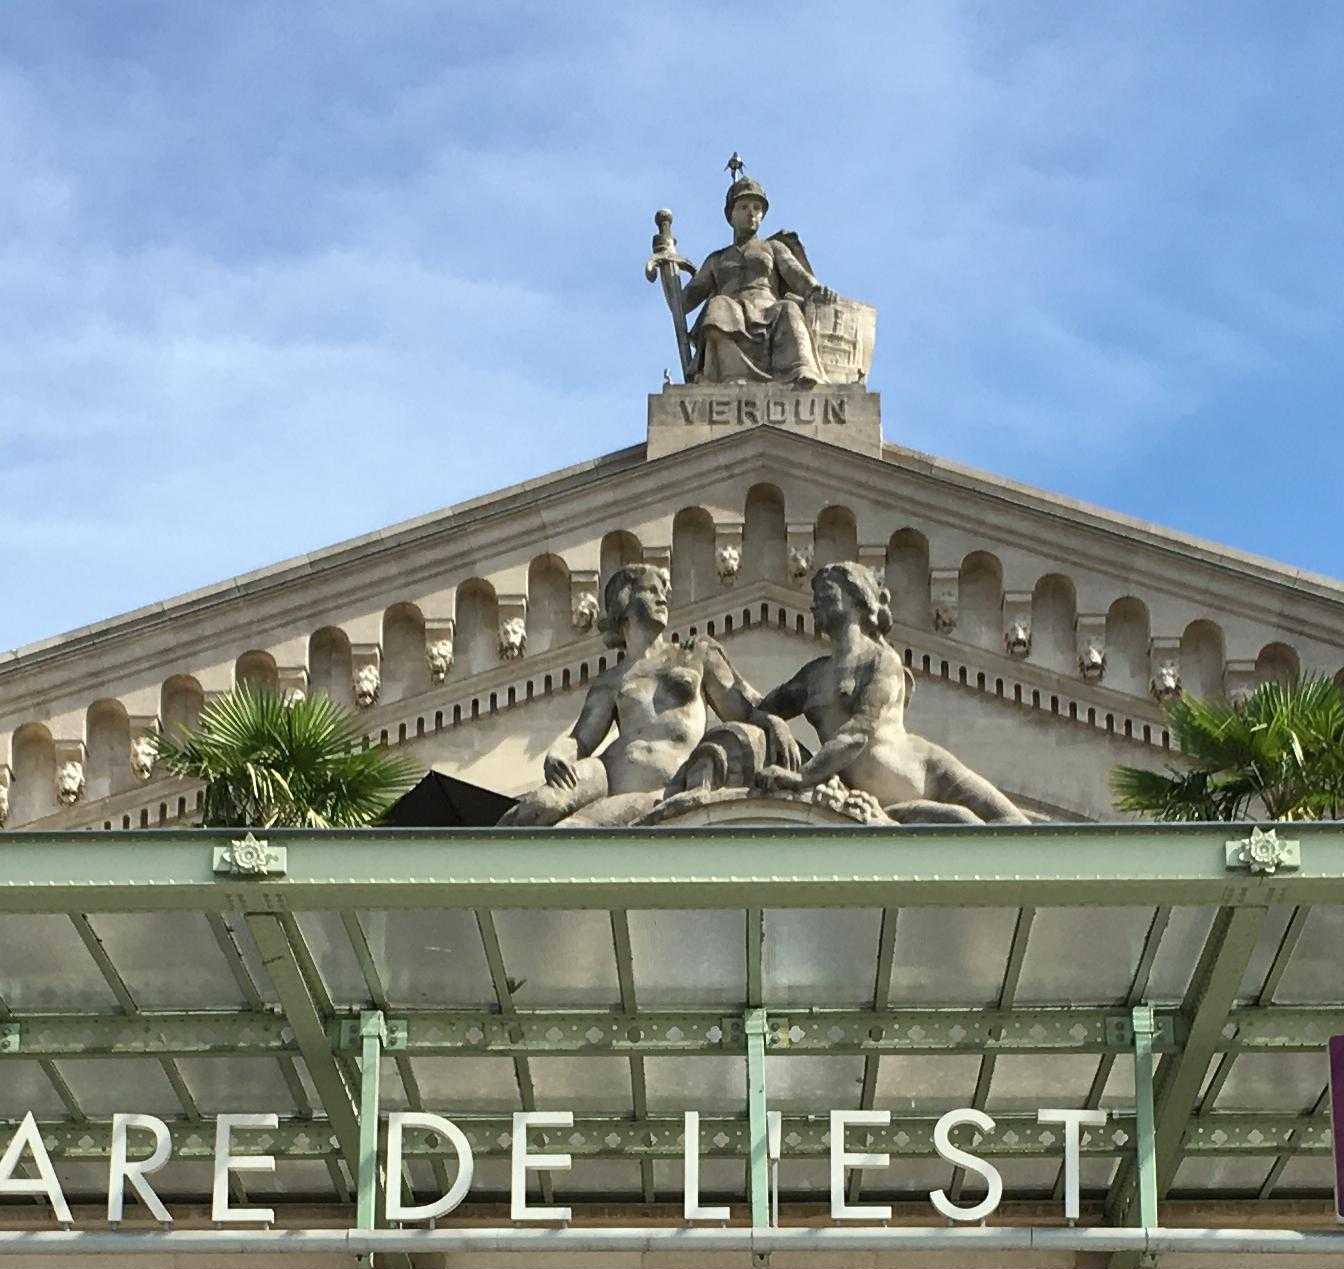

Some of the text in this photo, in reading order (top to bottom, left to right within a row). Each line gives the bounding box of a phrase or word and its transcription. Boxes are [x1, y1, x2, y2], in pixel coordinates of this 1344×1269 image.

[679, 397, 848, 425] VERDUN
[384, 1110, 574, 1222] DE
[684, 1107, 1108, 1222] L'EST
